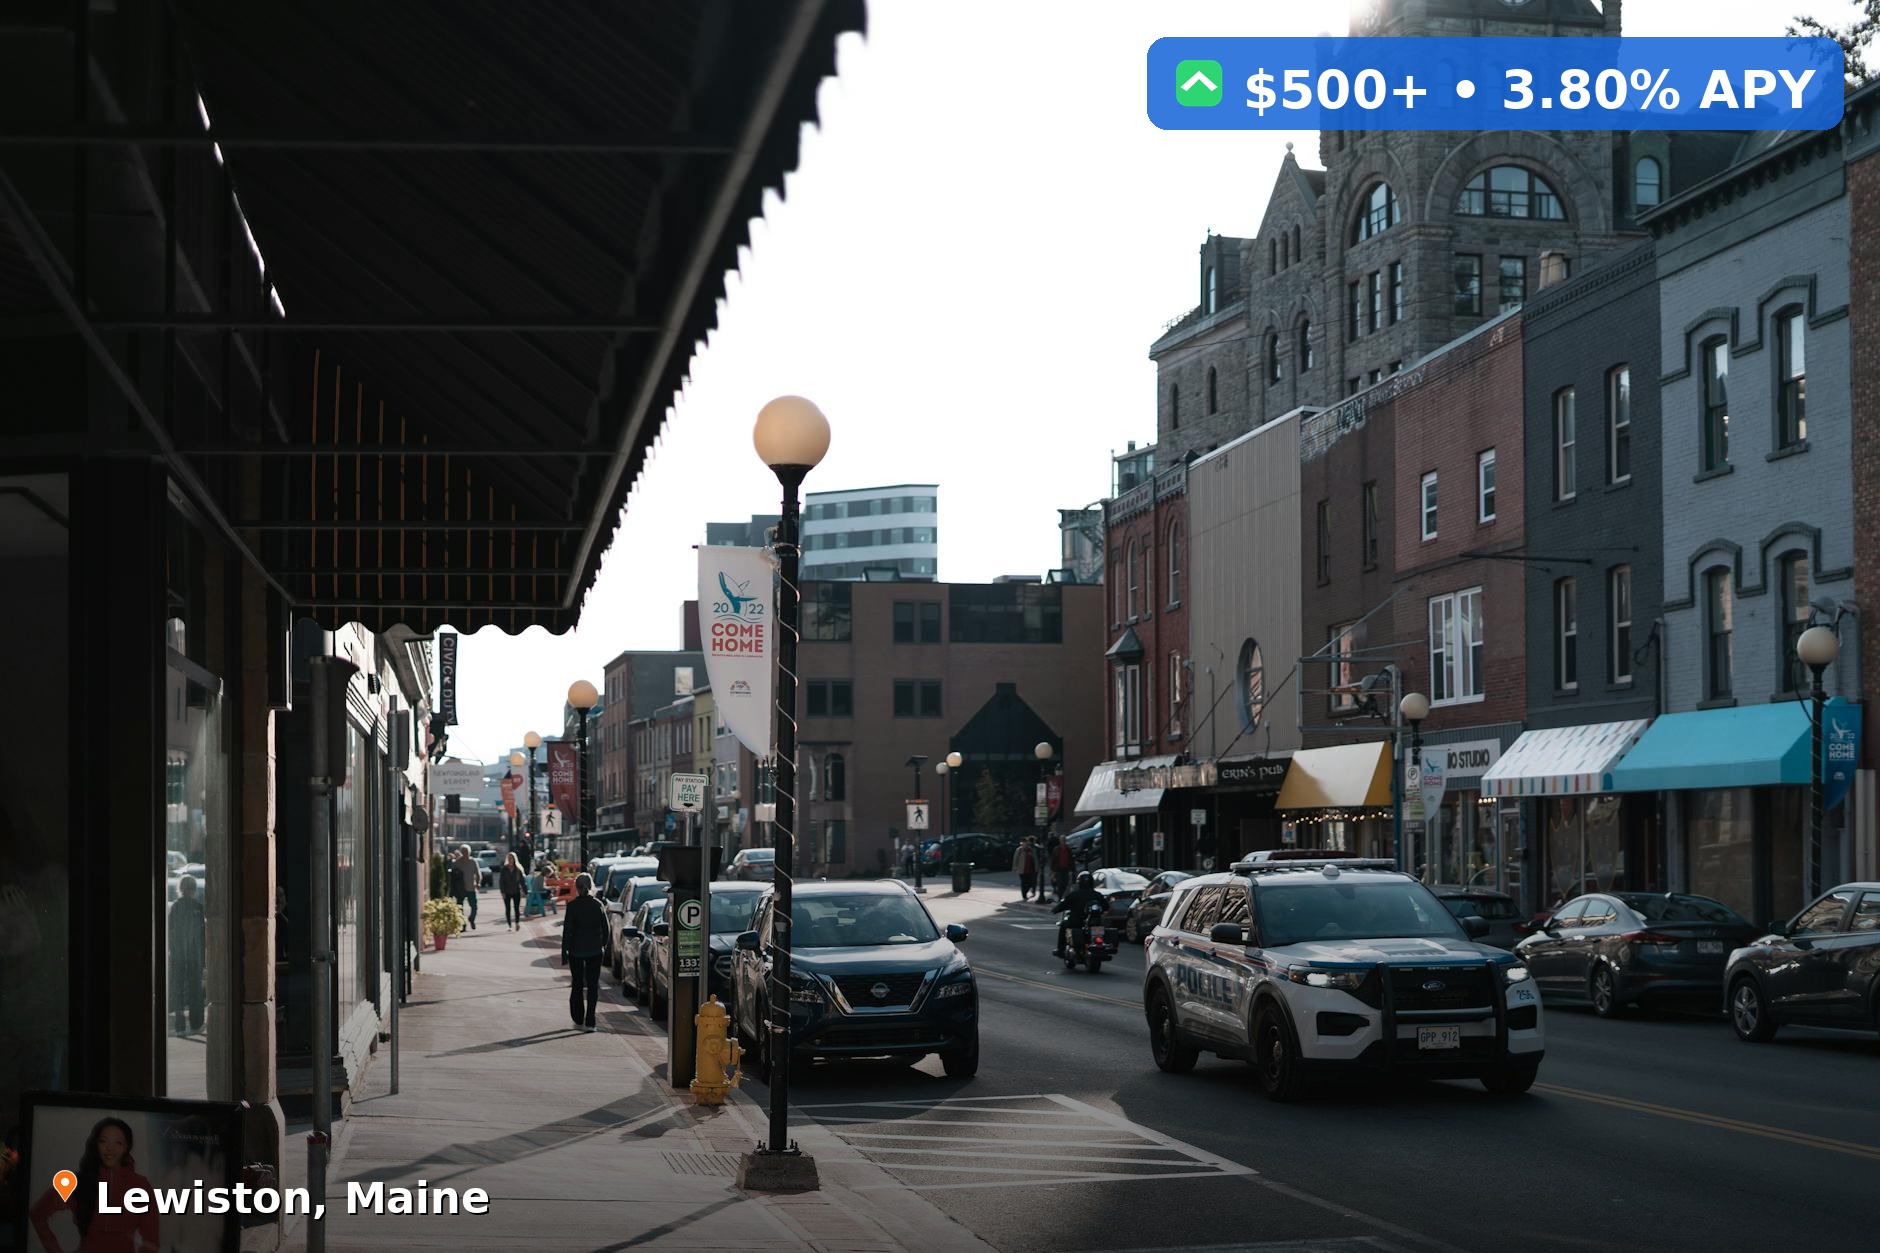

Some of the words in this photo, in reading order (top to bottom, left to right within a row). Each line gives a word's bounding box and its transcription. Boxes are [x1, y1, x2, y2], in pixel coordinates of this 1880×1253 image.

[713, 602, 729, 613] 20
[748, 603, 764, 614] 22
[711, 622, 764, 638] COME
[711, 638, 764, 653] HOME
[1828, 743, 1855, 751] COME
[1459, 748, 1490, 768] STUDIO
[1828, 751, 1856, 759] HOME
[1259, 764, 1284, 779] PUB
[682, 784, 697, 793] PAY
[677, 793, 700, 803] HERE
[687, 906, 700, 924] P
[1177, 964, 1233, 1004] POLICE
[1420, 1031, 1437, 1042] GPP
[1441, 1031, 1458, 1042] 912
